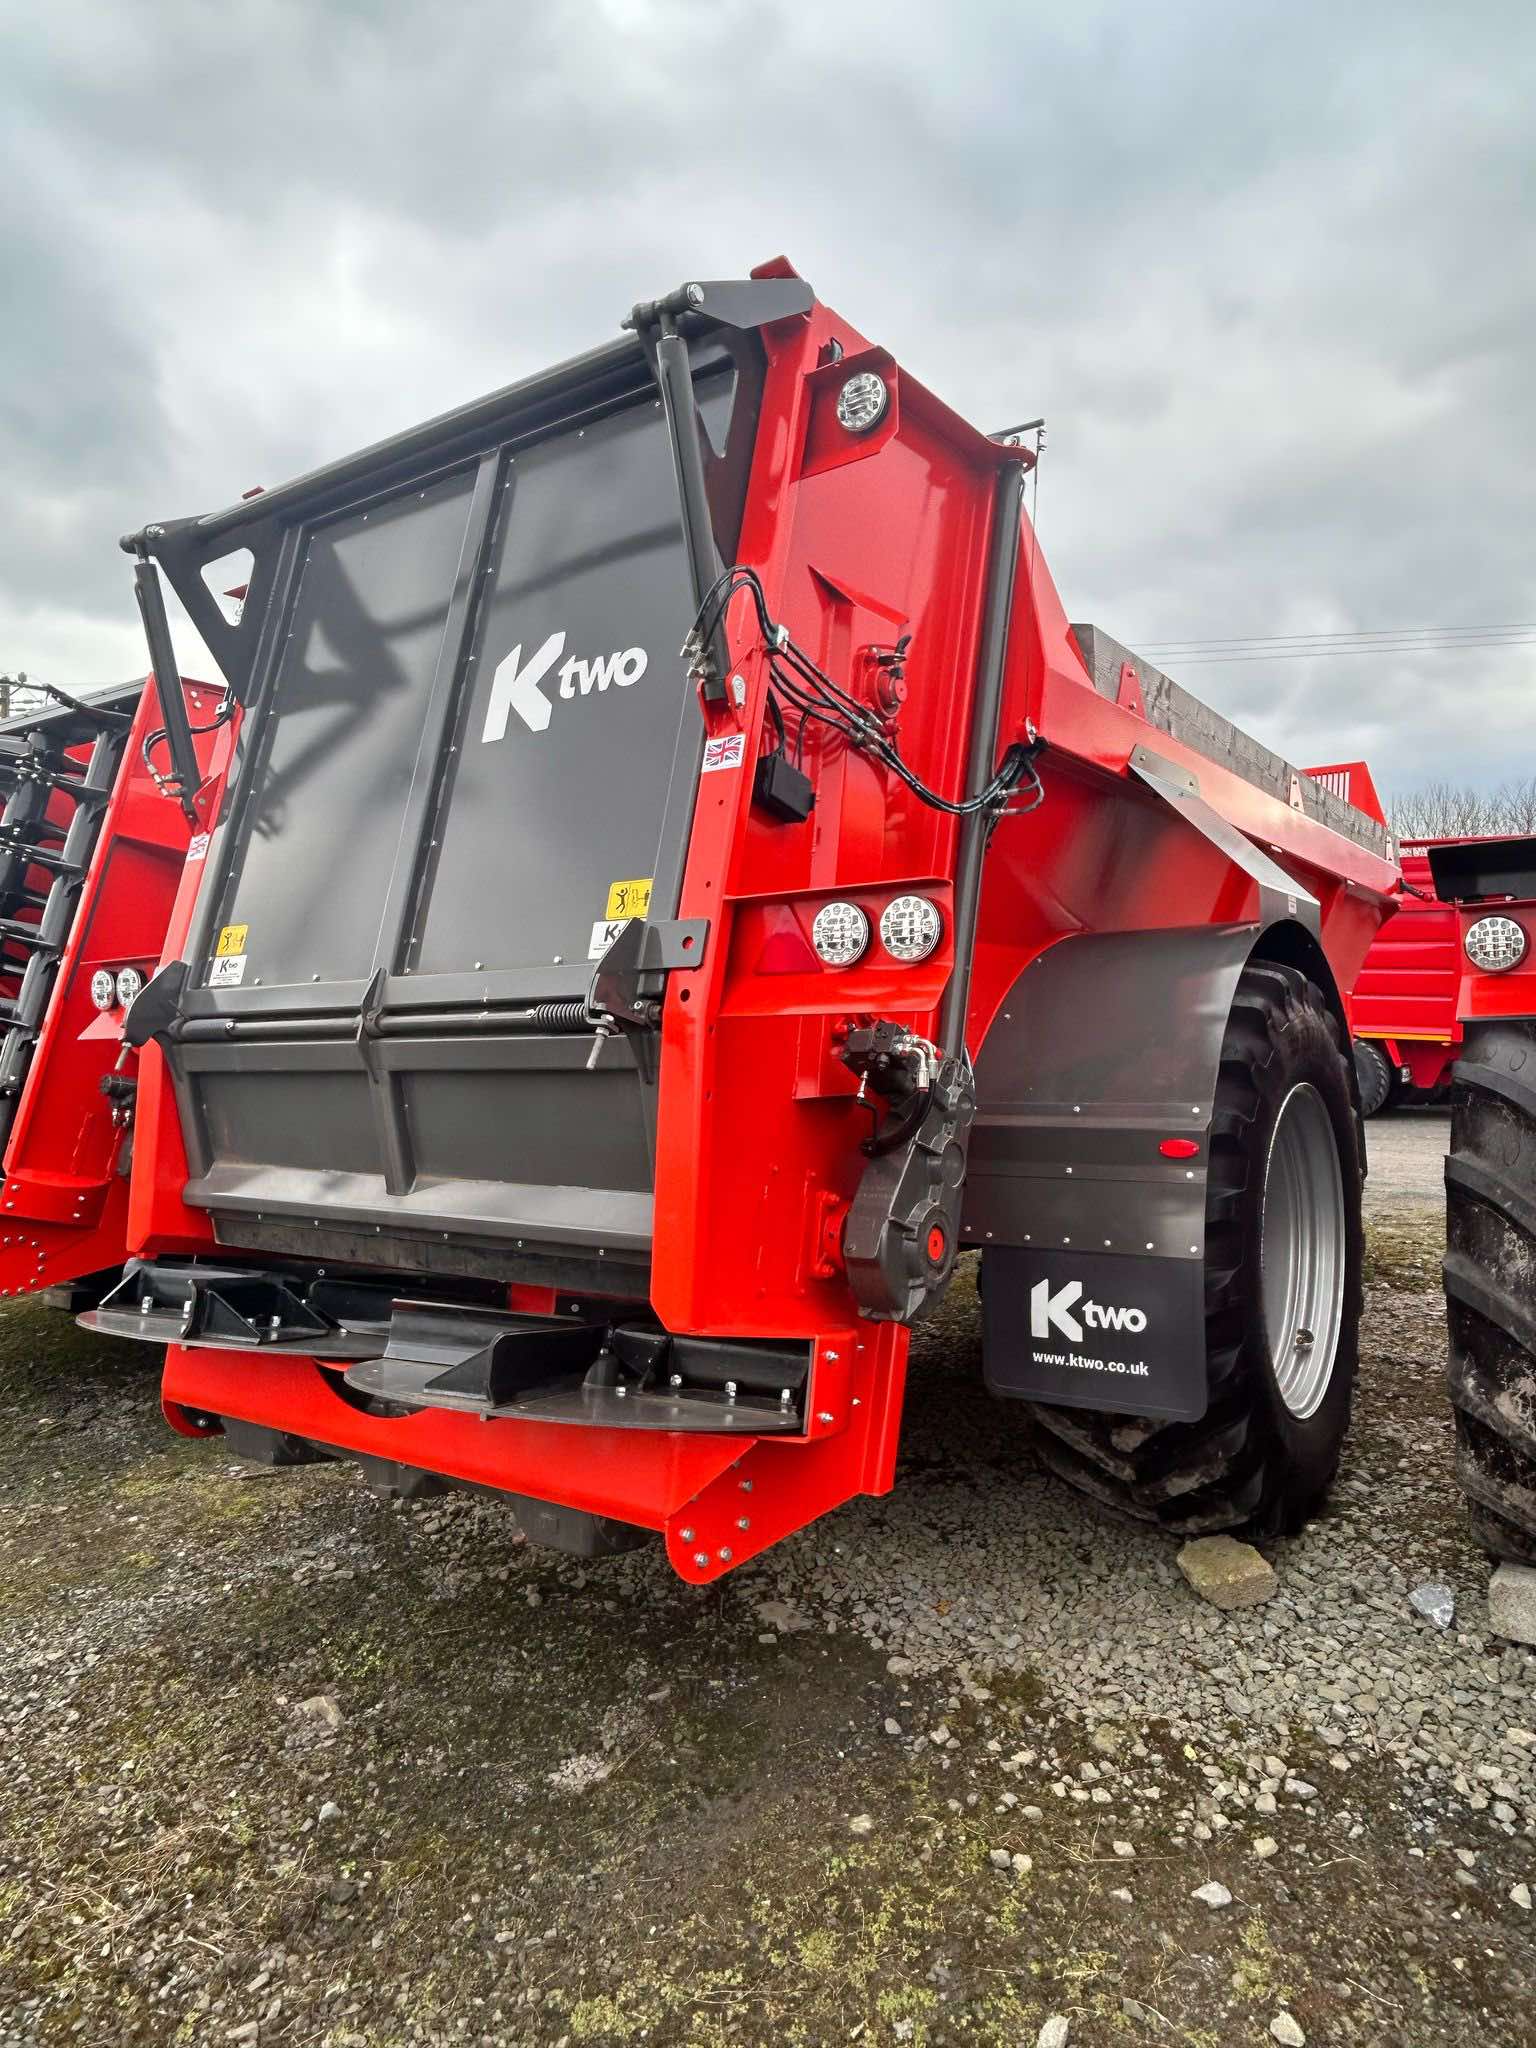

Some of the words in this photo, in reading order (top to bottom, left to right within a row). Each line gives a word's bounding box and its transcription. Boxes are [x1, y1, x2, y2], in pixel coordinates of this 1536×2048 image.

[481, 631, 648, 743] Ktwo
[1030, 1278, 1148, 1343] Ktwo
[1032, 1351, 1150, 1376] www.ktwo.co.uk
